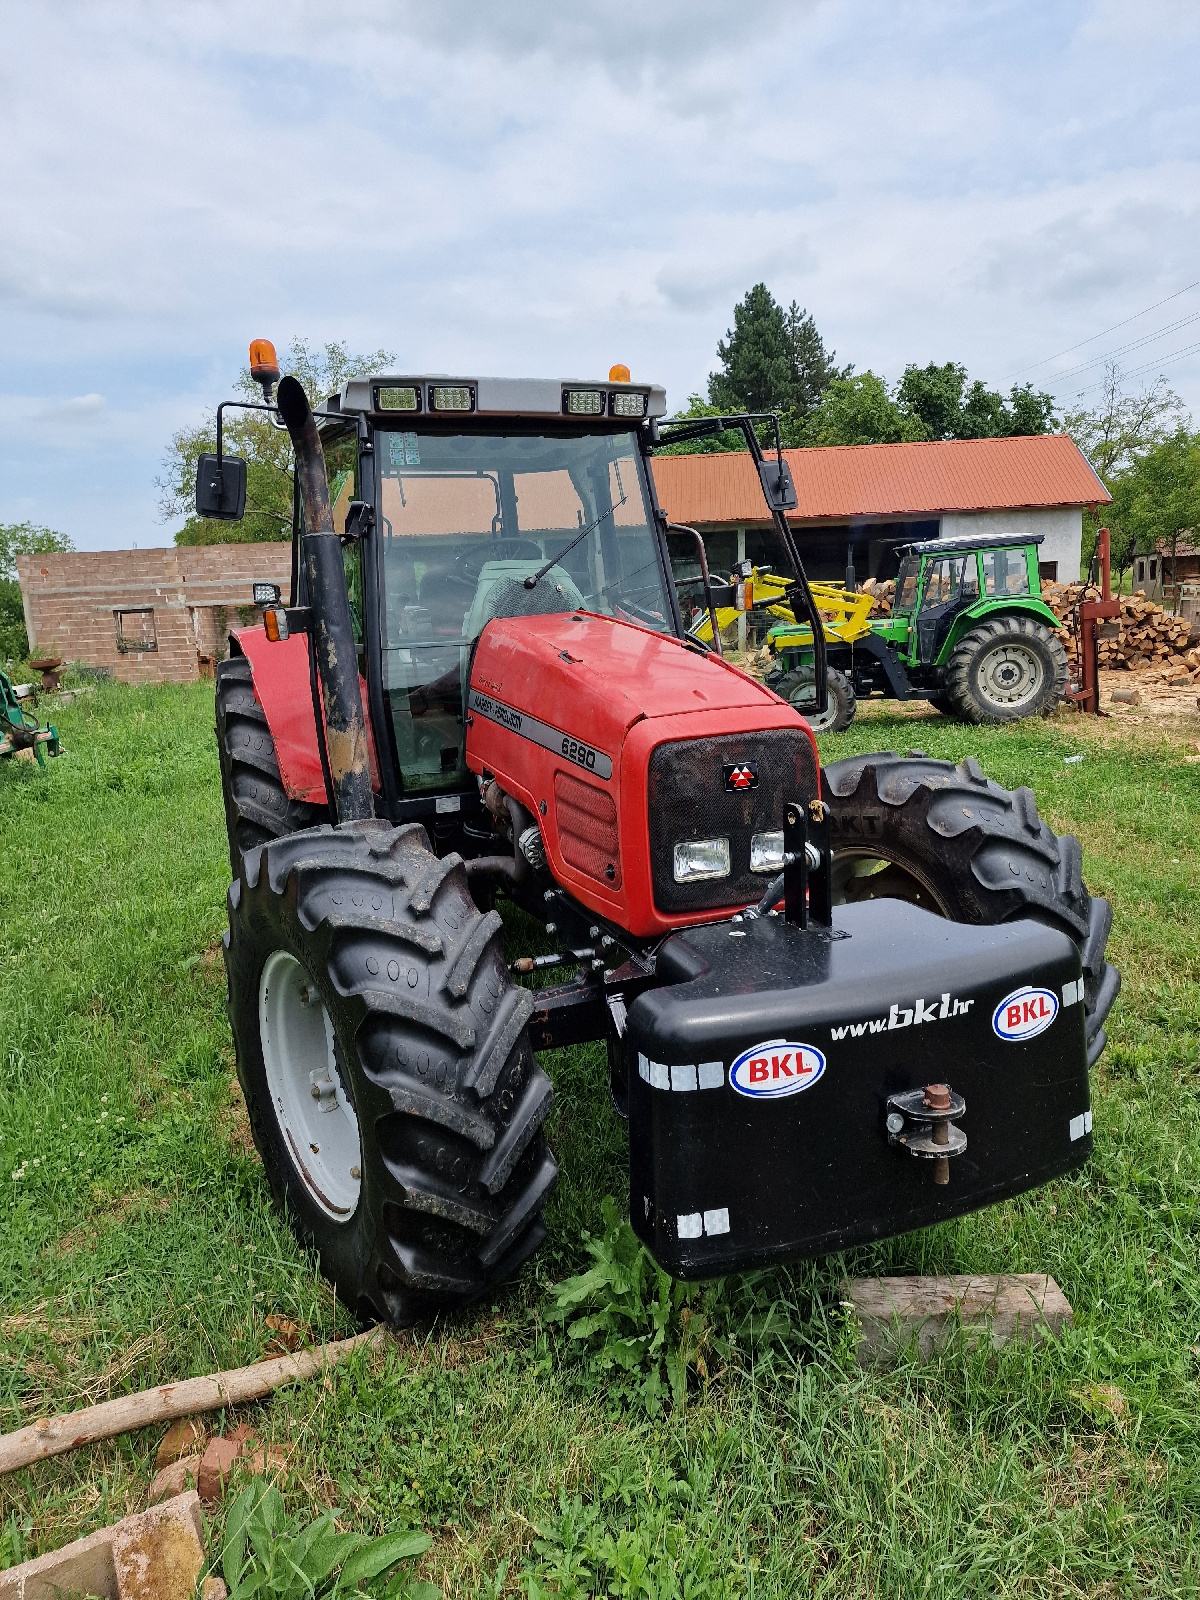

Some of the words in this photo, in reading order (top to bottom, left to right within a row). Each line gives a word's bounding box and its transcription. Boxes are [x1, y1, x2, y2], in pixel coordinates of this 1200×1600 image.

[561, 737, 596, 769] 6290
[830, 992, 975, 1041] www.bkl.hr
[1006, 996, 1051, 1029] BKL
[749, 1051, 813, 1083] BKL
